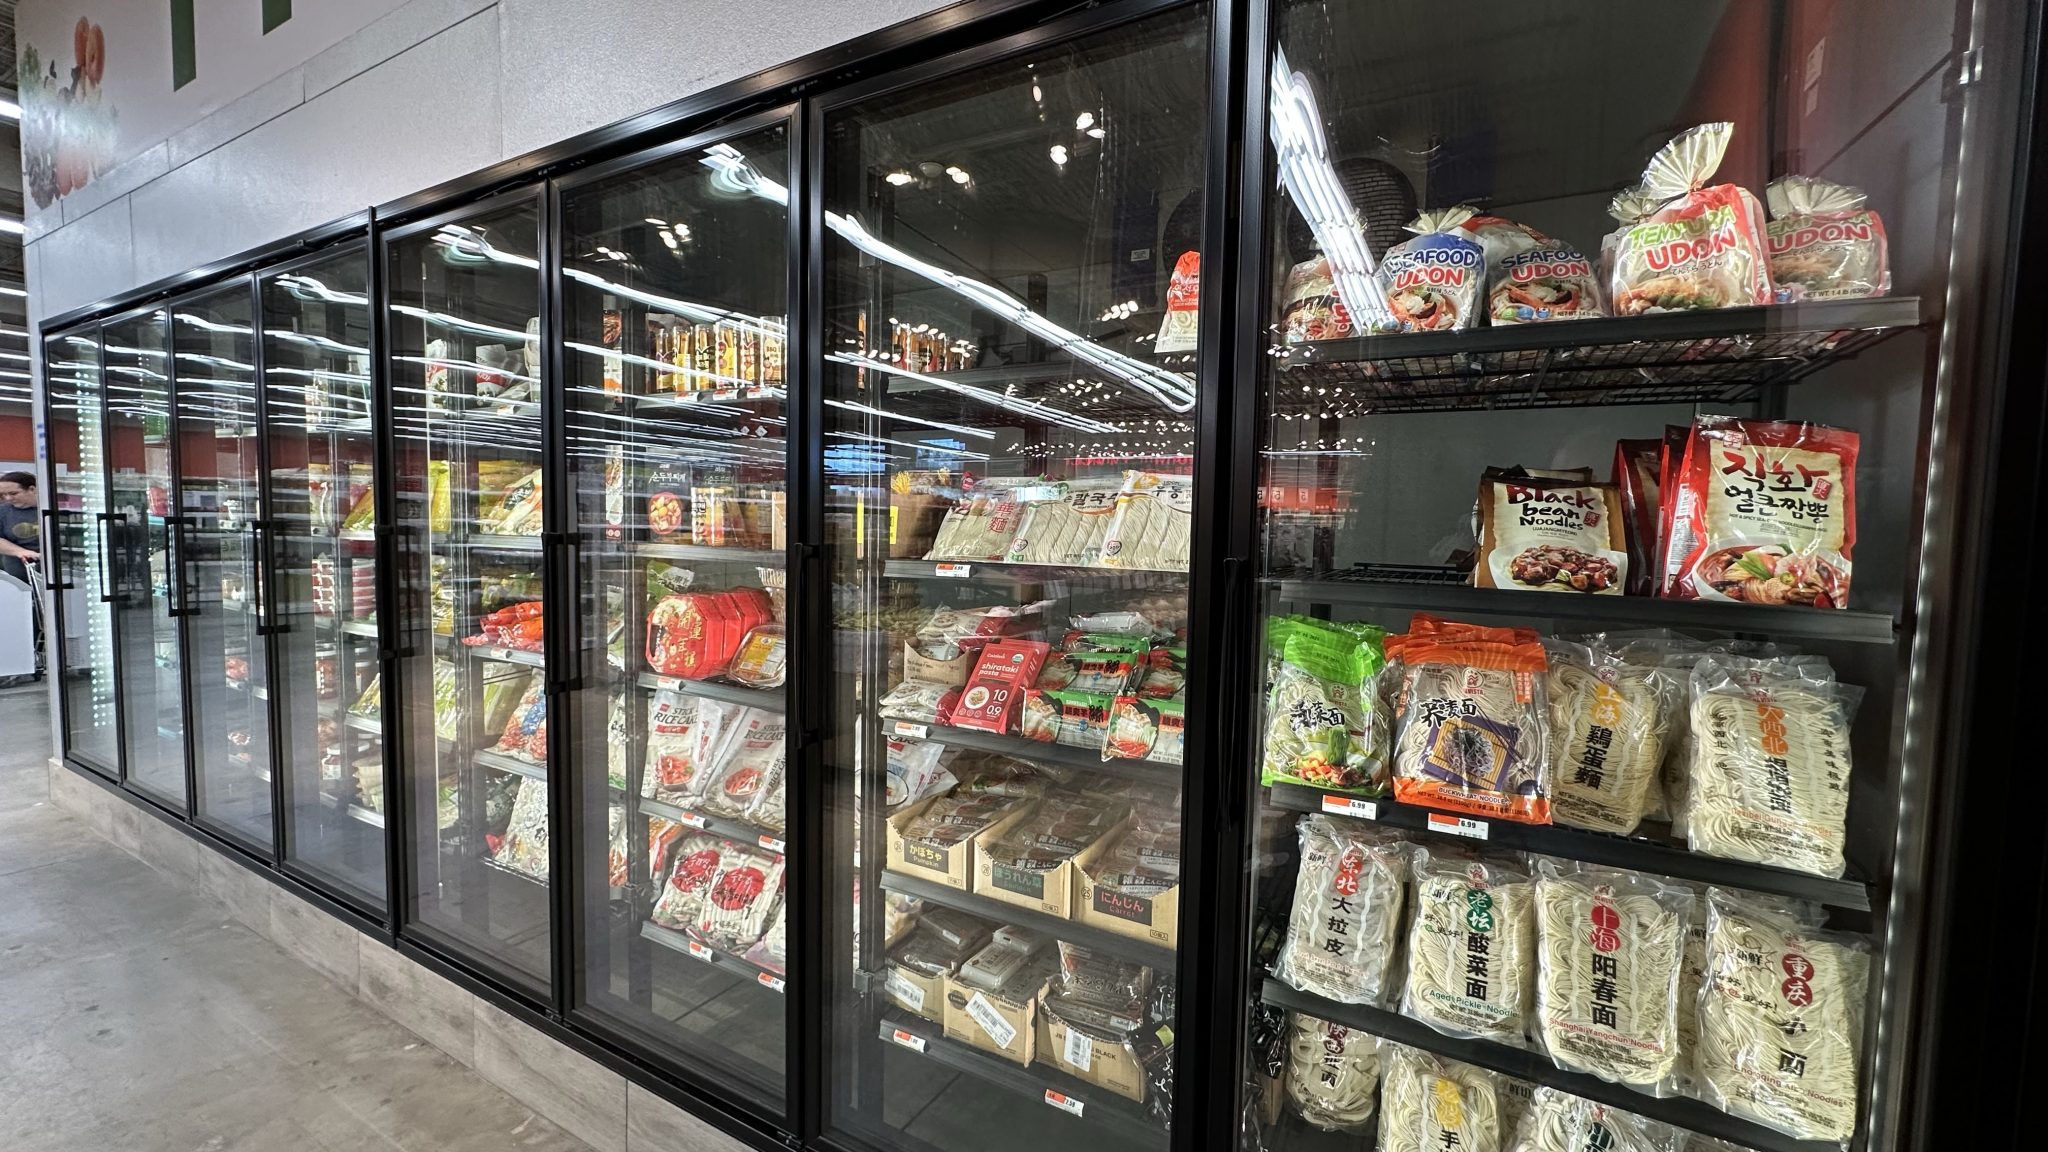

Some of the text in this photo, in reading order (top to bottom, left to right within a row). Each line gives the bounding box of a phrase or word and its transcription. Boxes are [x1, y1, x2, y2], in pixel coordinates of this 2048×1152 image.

[1768, 223, 1873, 254] UDON
[1645, 228, 1737, 272] UDON
[1501, 250, 1586, 268] SEAFOO
[1396, 266, 1465, 290] UDON
[1511, 261, 1592, 282] UDON
[1523, 503, 1580, 520] bean
[1519, 516, 1584, 530] Noodles
[981, 662, 1019, 673] shirataki
[993, 689, 1008, 702] 10
[654, 712, 679, 724] RICE
[1351, 801, 1365, 810] 6.99
[1460, 820, 1476, 829] 6.99
[909, 845, 942, 861] かぼちゃ
[1101, 890, 1144, 912] にんじん
[1109, 906, 1135, 918] Carrot
[1429, 989, 1520, 1018] Aged Pickle Noodle
[1550, 1018, 1664, 1053] Shanghai Yangchun Noodles
[1095, 1048, 1116, 1060] BLACK
